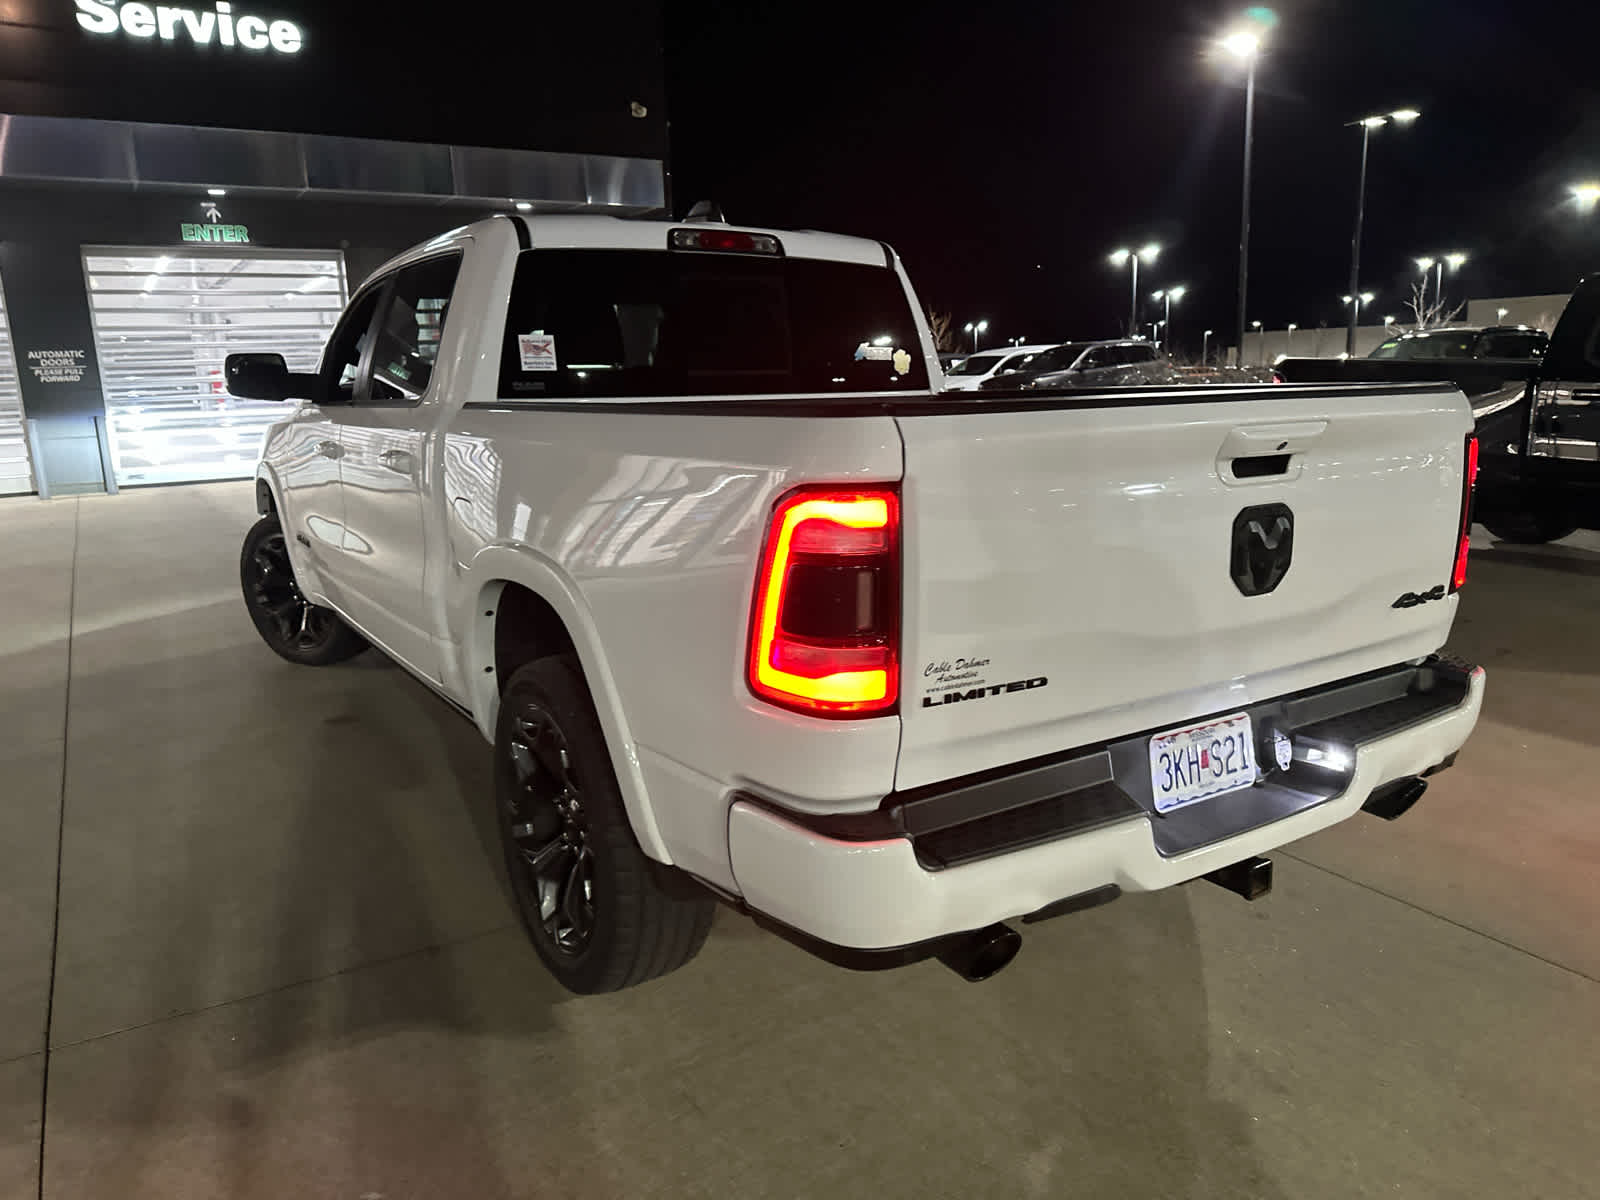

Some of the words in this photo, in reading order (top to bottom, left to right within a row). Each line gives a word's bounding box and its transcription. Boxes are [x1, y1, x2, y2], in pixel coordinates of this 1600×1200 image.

[75, 0, 302, 53] Service
[181, 223, 250, 243] ENTER
[28, 350, 85, 359] AUTOMATIC
[34, 368, 62, 376] PLEASE
[40, 375, 80, 383] FORWARD
[924, 662, 952, 677] Cable
[923, 677, 1048, 707] LIMITED
[1159, 744, 1201, 793] 3KH
[1210, 731, 1249, 777] S21
